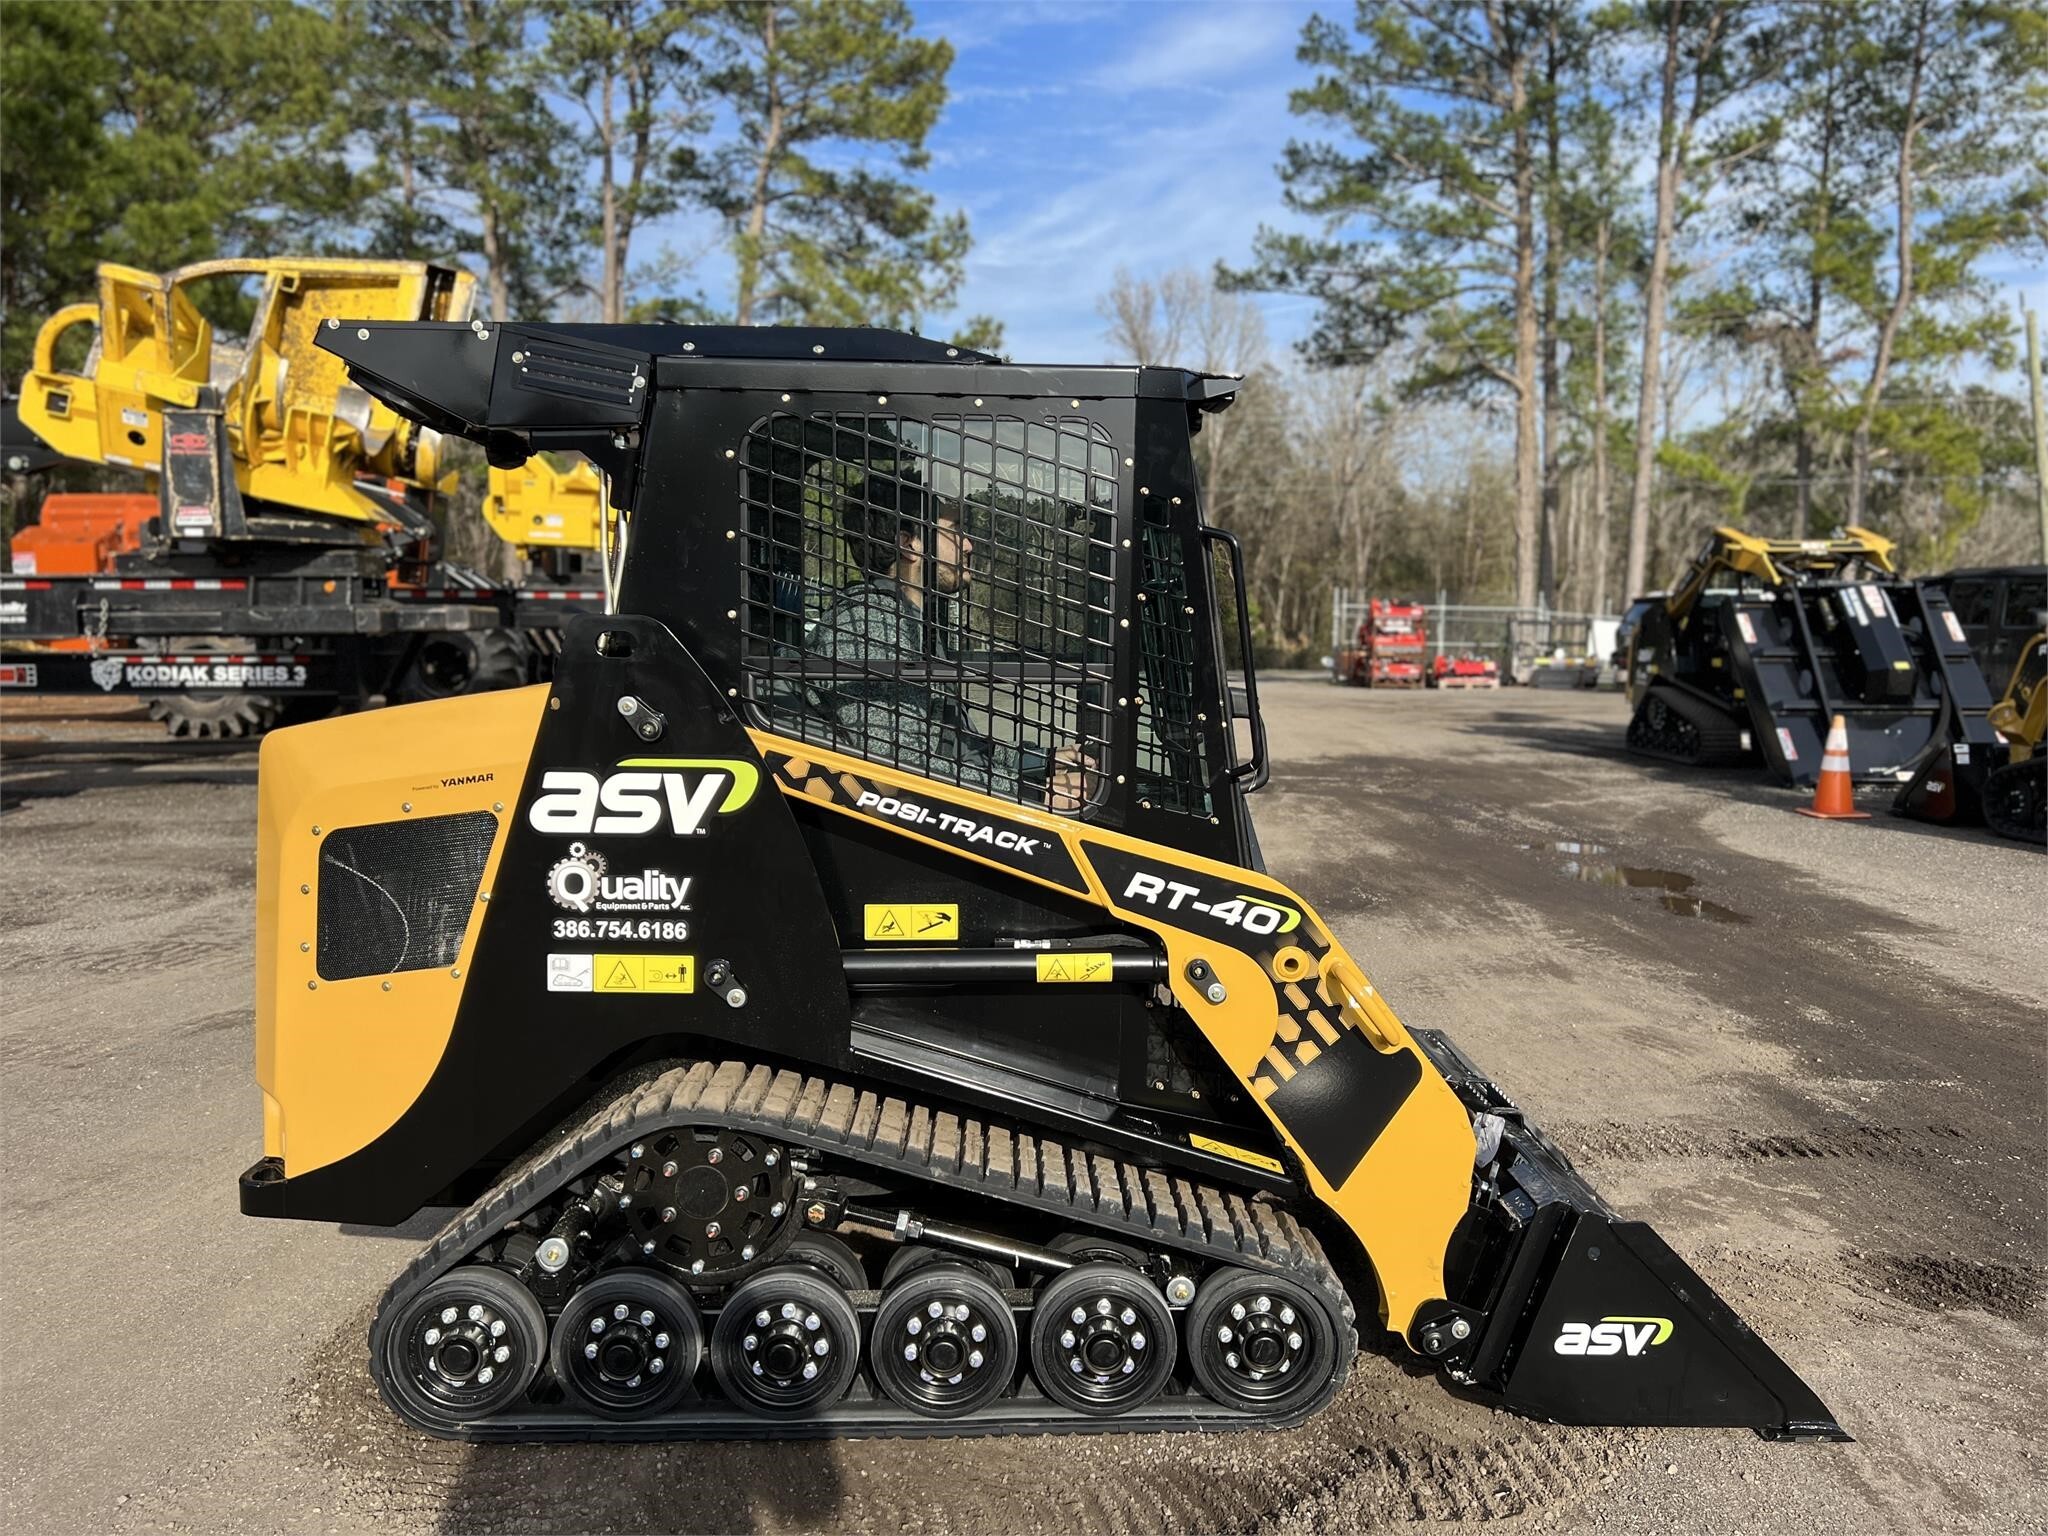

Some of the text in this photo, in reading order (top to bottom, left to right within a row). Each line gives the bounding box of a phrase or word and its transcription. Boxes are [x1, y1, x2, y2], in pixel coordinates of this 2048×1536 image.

[127, 666, 307, 682] KODIAK SERIES 3
[441, 773, 494, 787] YANMAR
[856, 791, 1039, 856] POSI-TRACK
[557, 866, 691, 912] Quality
[596, 902, 640, 912] Equipment
[650, 902, 670, 911] Parts
[1123, 871, 1281, 935] RT-40
[553, 919, 687, 940] 386.754.6186
